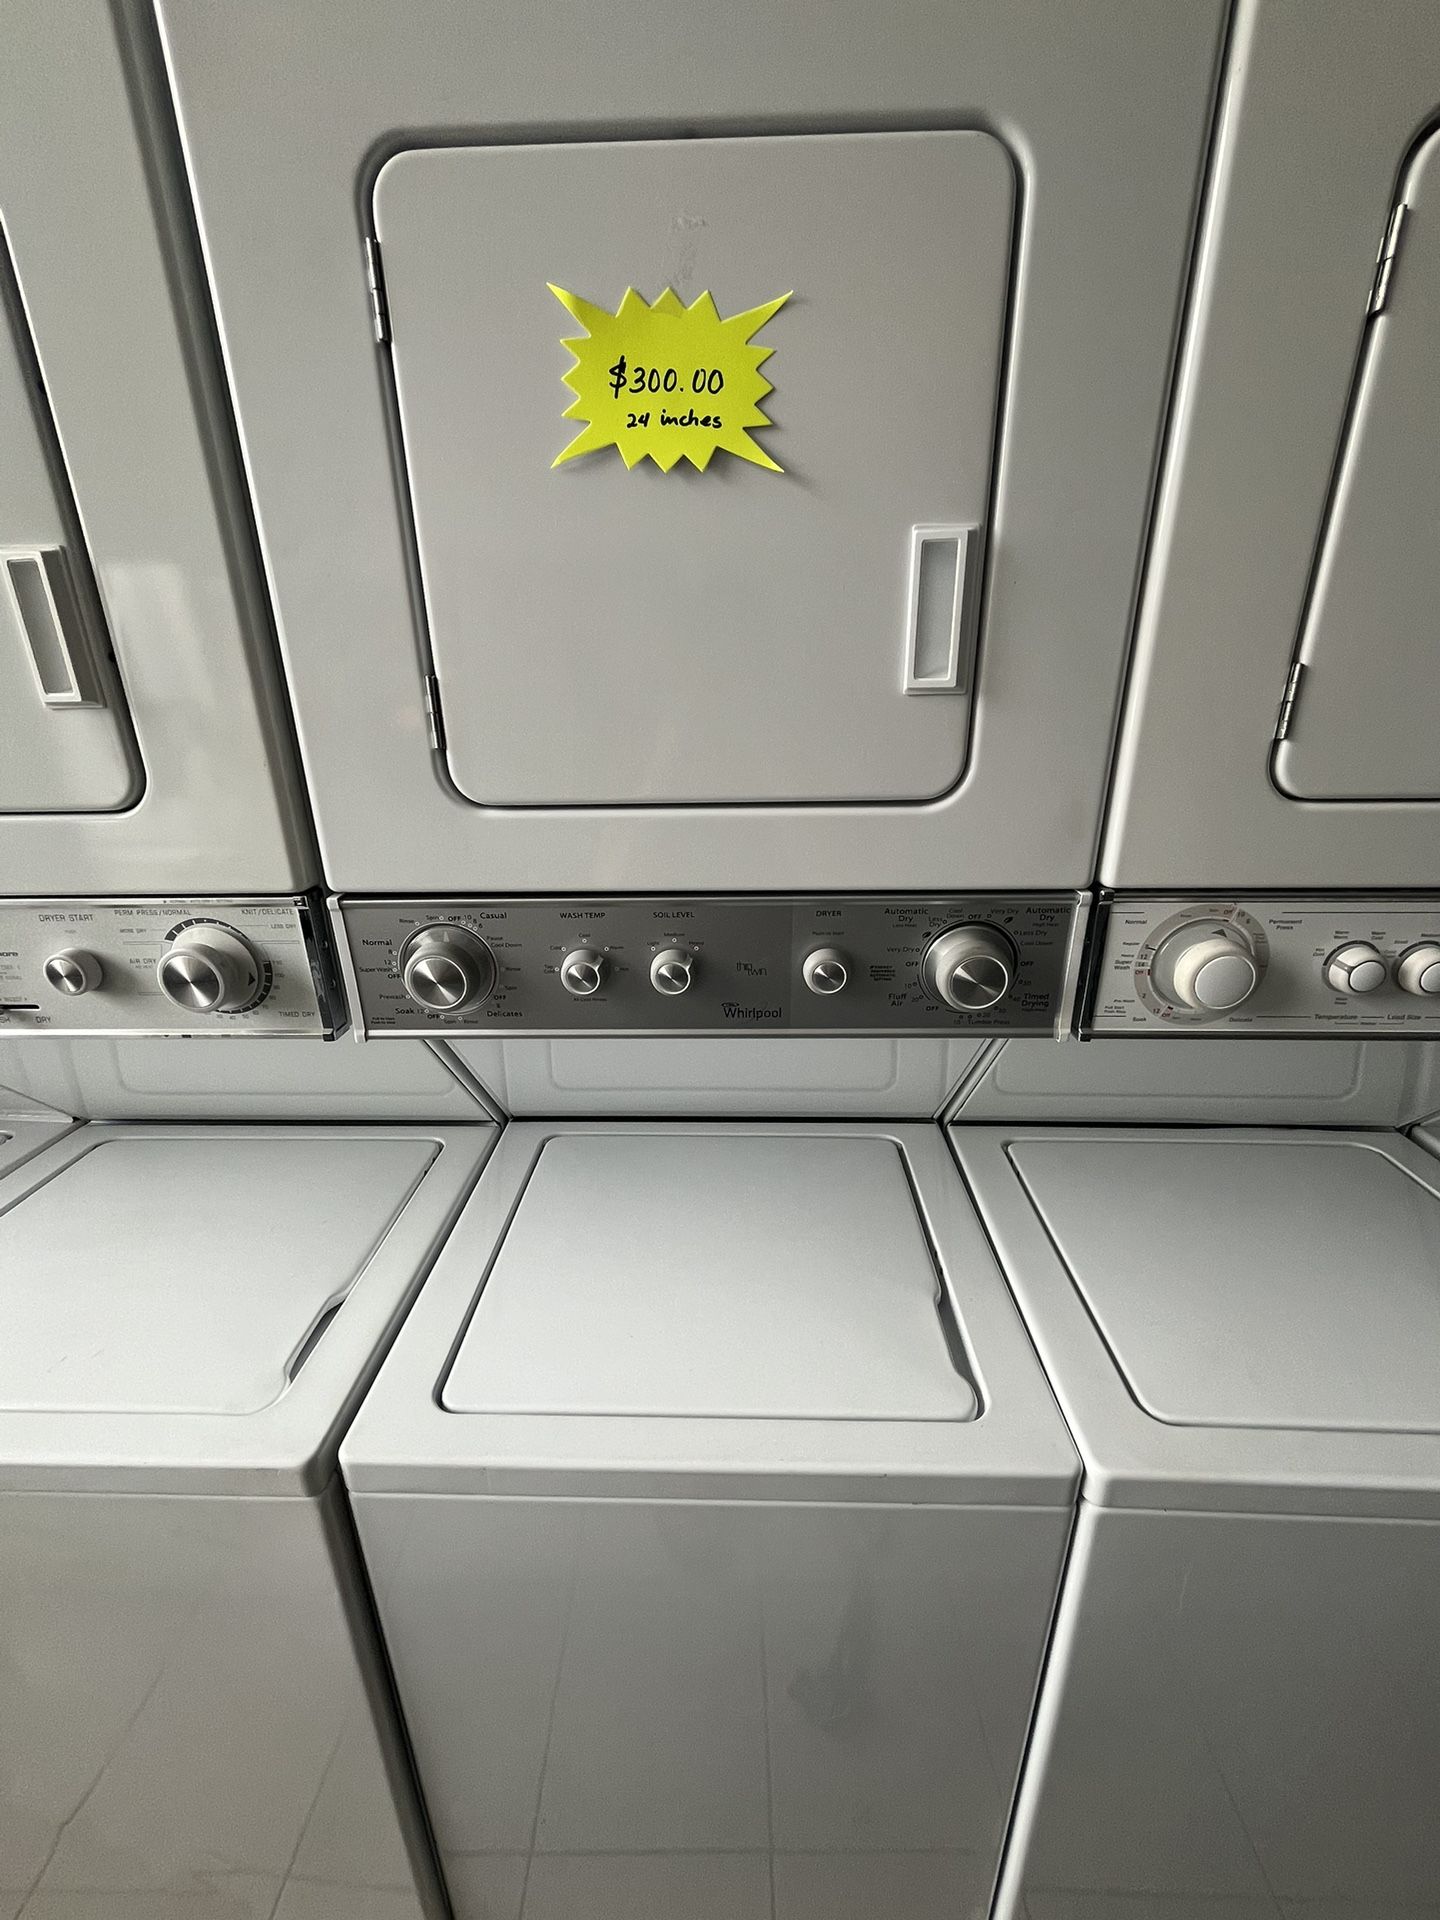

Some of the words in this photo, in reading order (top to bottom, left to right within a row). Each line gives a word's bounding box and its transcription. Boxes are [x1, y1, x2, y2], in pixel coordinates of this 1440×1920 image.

[608, 355, 724, 399] $300.00
[626, 412, 650, 428] 24
[660, 408, 722, 429] inches
[653, 911, 670, 919] SOIL
[672, 911, 695, 919] LEVEL
[1025, 907, 1071, 915] Automatic
[38, 914, 65, 922] DRYER
[69, 914, 94, 922] START
[480, 912, 507, 920] Casual
[898, 915, 914, 923] Dry
[1040, 914, 1055, 922] Dry
[1021, 999, 1049, 1008] Drying
[723, 1007, 781, 1021] Whirlpool
[35, 1016, 51, 1024] DRY
